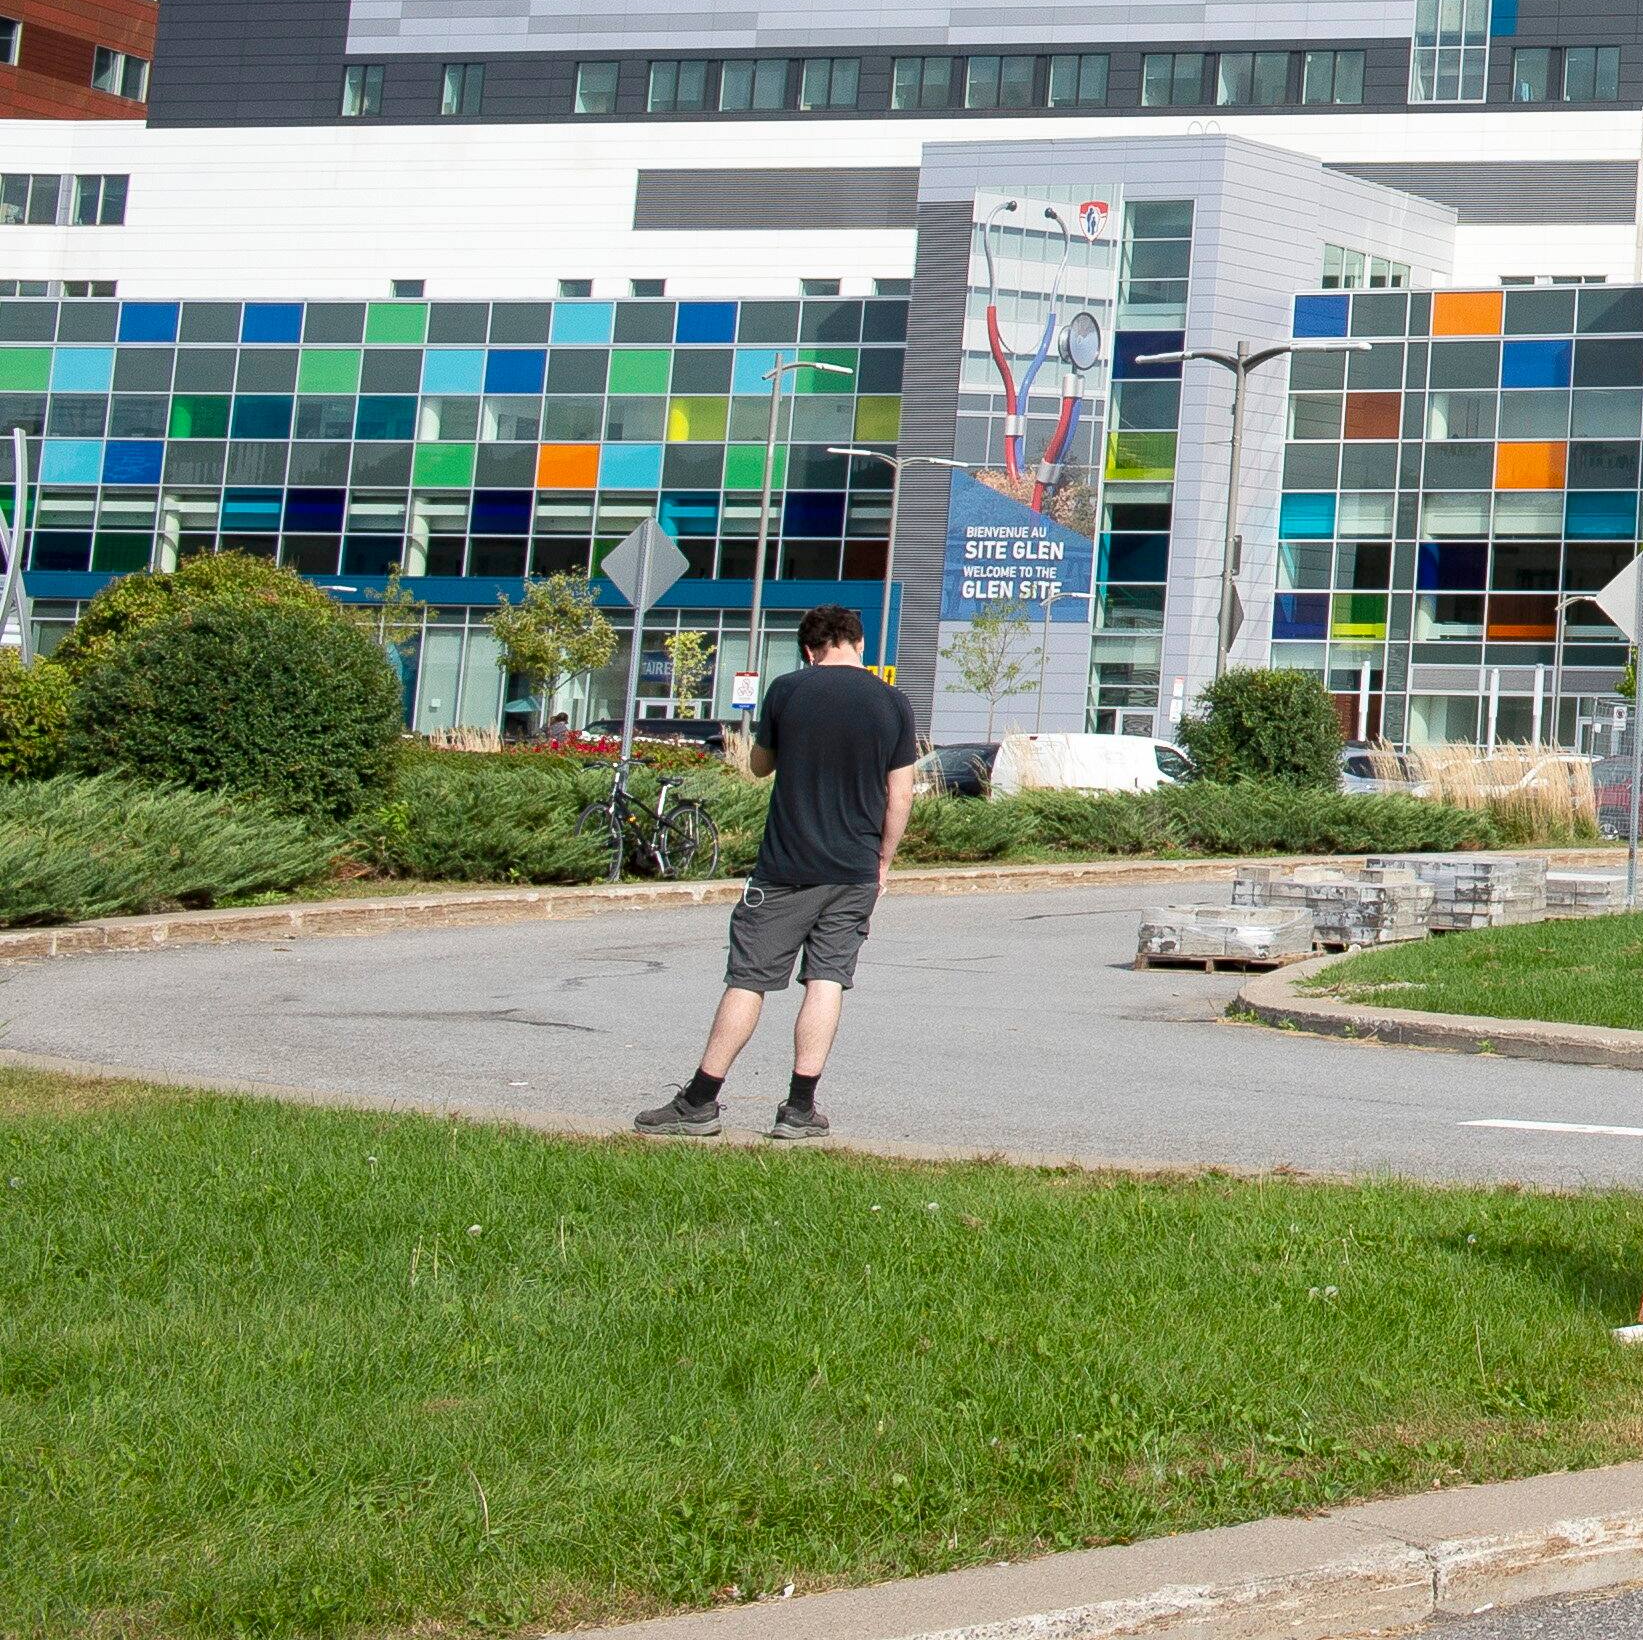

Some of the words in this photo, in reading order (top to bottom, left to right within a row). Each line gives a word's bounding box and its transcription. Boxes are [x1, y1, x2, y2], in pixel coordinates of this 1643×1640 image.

[966, 526, 1029, 538] BIENVENUE
[1030, 526, 1047, 538] AU
[965, 540, 1007, 559] SITE
[1013, 541, 1064, 560] GLEN
[963, 566, 1017, 578] WELCOME
[1019, 566, 1033, 578] TO
[1036, 567, 1057, 579] THE
[962, 580, 1014, 599] GLEN
[1019, 581, 1062, 600] SITE
